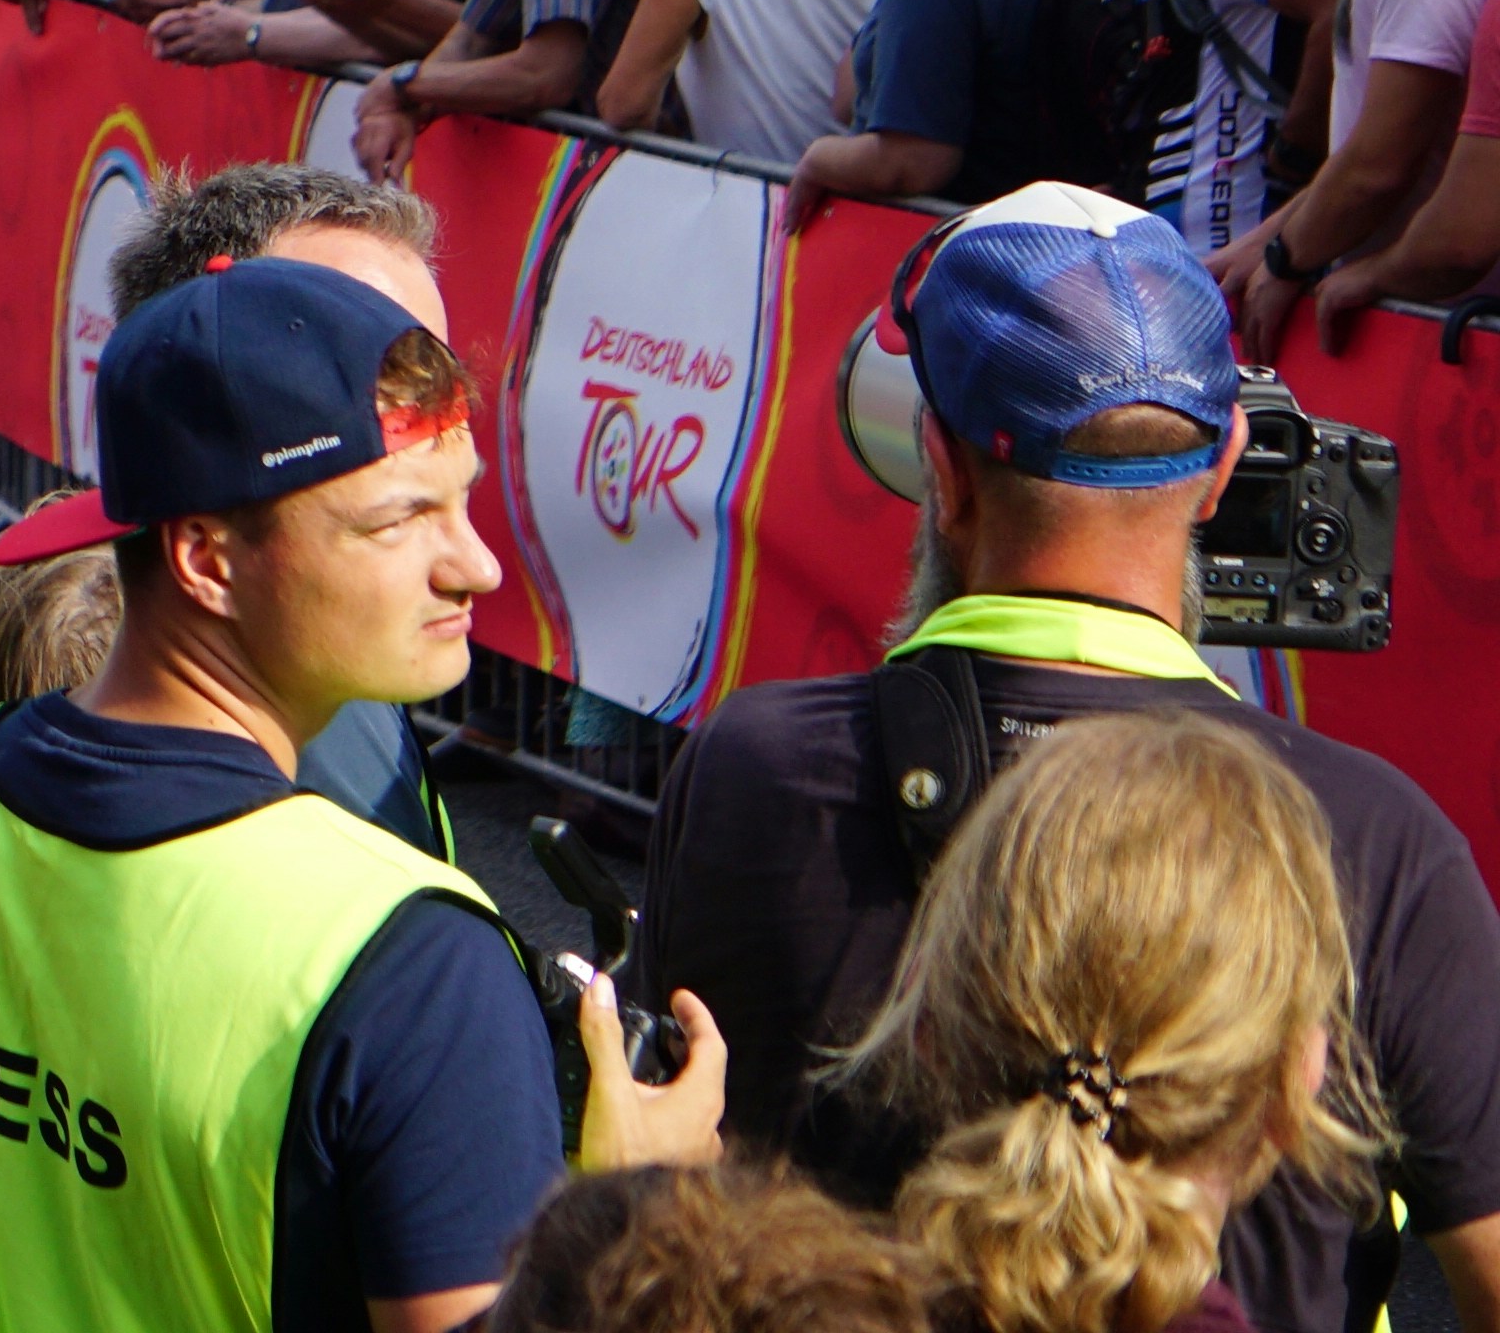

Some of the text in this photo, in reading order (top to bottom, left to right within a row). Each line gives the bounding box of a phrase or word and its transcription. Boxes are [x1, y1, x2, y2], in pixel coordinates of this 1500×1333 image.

[578, 314, 734, 392] DEUTSCHLAND
[261, 434, 342, 469] @planpfilm
[574, 377, 707, 544] TOUR
